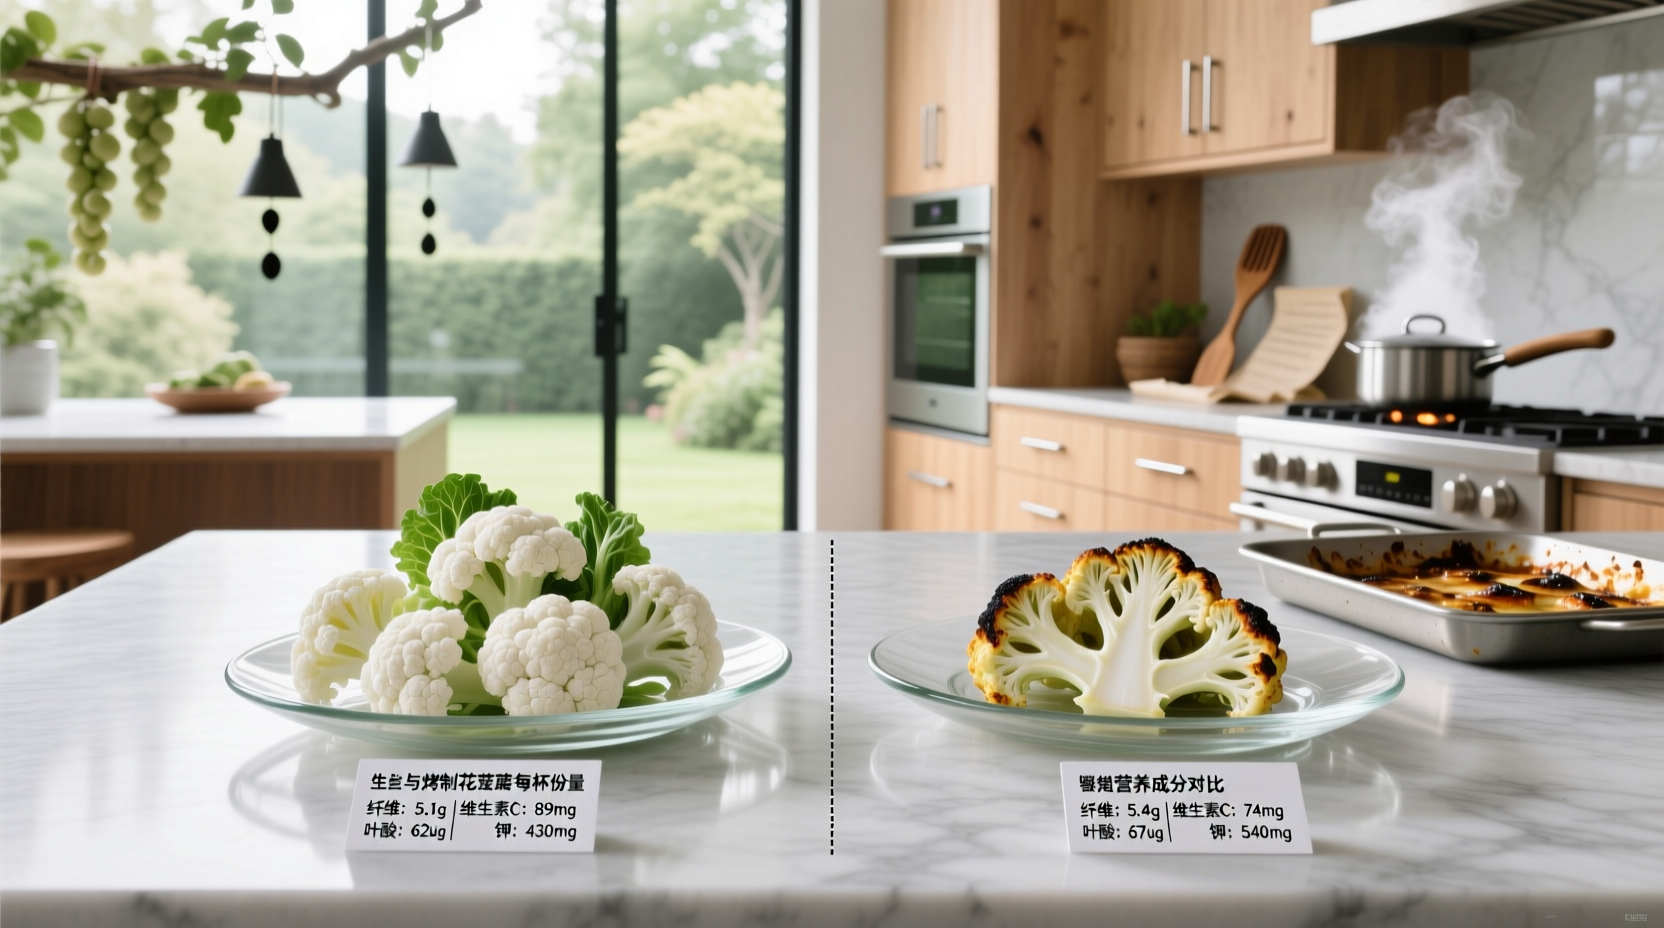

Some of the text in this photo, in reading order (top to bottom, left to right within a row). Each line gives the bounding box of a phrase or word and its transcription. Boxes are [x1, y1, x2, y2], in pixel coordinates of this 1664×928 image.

[414, 801, 447, 820] 5.1g
[535, 801, 576, 820] 89mg
[1127, 803, 1160, 821] 5.4g
[1244, 803, 1284, 821] 74mg
[525, 824, 577, 842] 430mg
[1128, 824, 1164, 843] 67ug
[1241, 824, 1292, 843] 540mg
